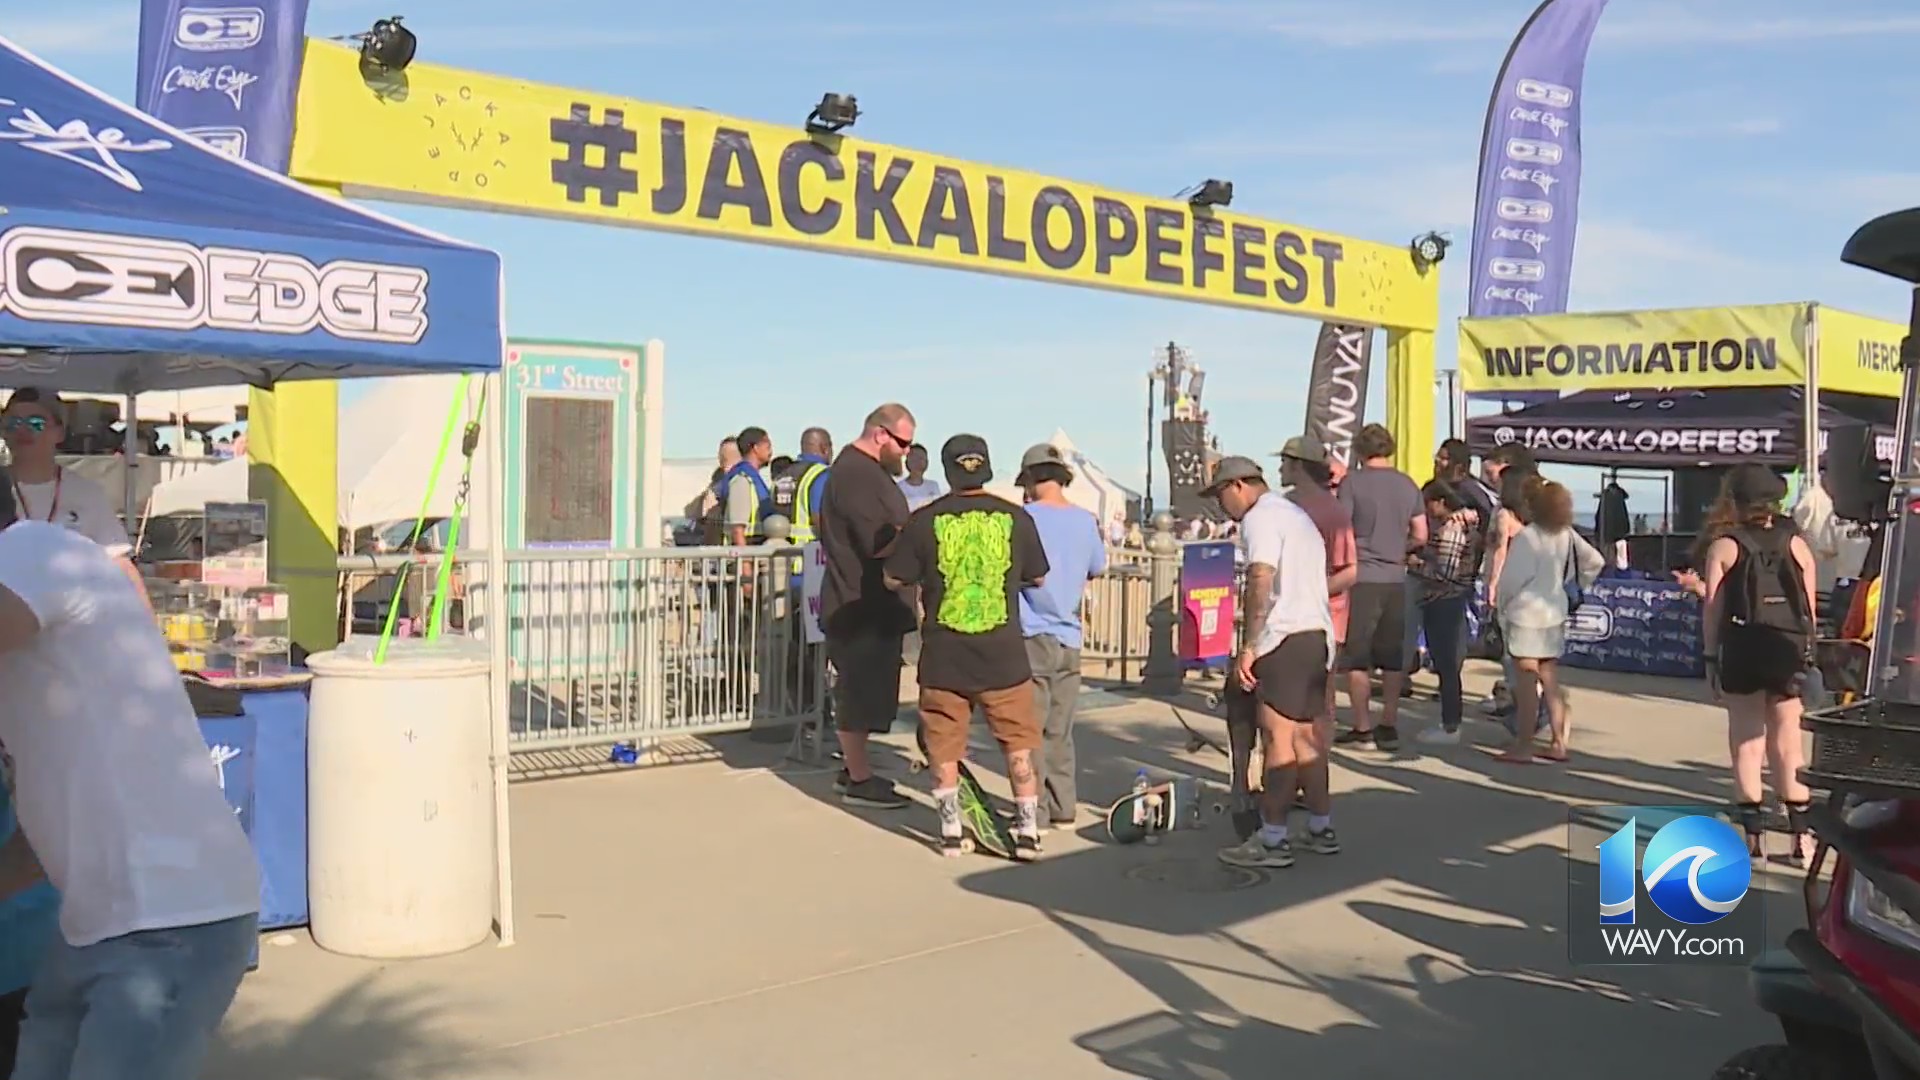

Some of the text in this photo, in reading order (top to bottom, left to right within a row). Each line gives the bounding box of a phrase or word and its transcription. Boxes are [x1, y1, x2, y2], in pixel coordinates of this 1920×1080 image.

[550, 102, 1344, 308] #JACKALOPEFEST
[206, 249, 427, 341] EDGE
[1485, 337, 1777, 377] INFORMATION
[1858, 339, 1903, 373] MERC
[562, 364, 623, 392] Street
